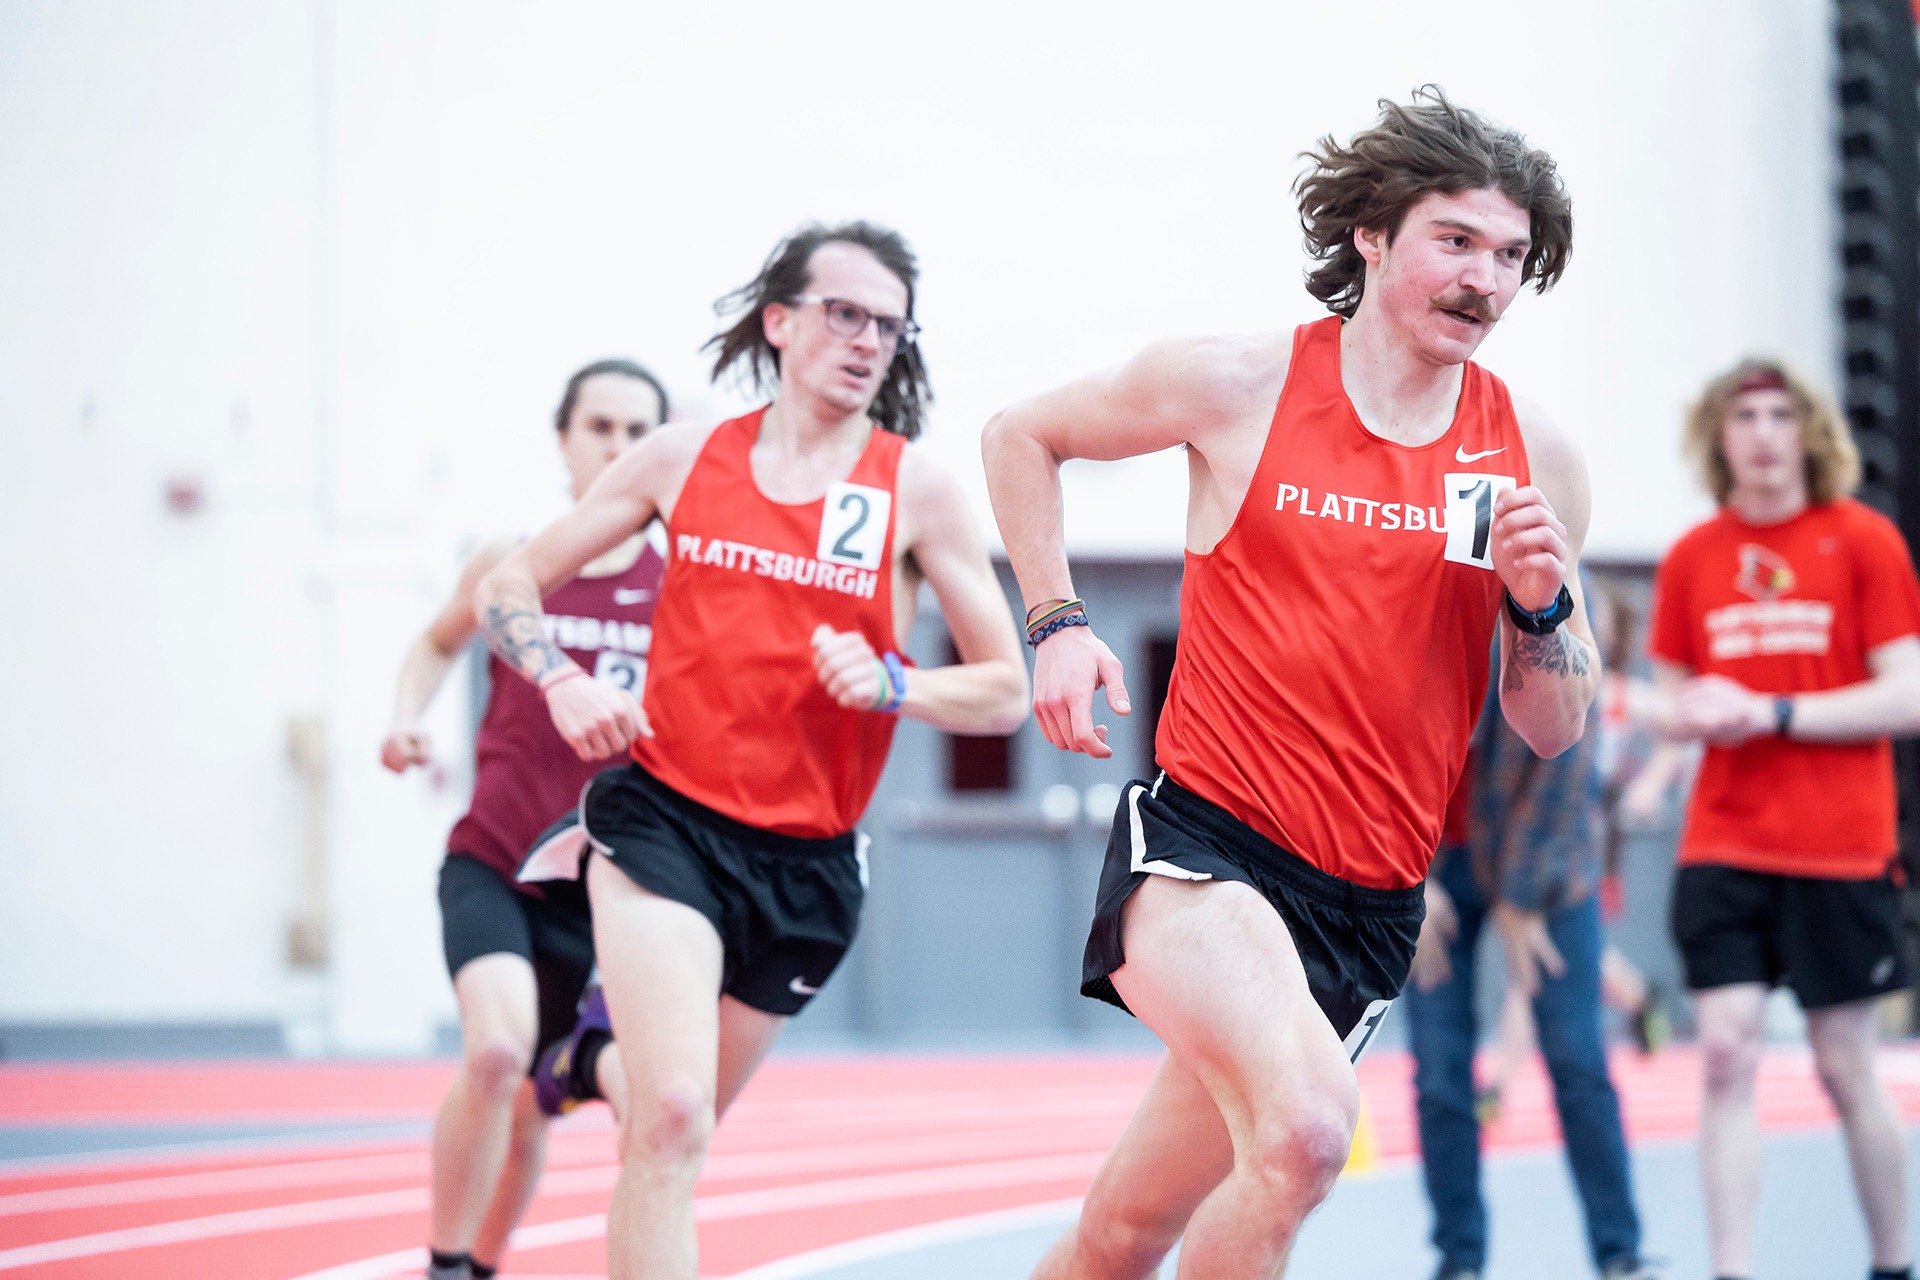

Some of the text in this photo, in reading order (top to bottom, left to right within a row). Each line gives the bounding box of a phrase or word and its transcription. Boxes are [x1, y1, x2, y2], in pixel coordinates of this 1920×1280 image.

[831, 494, 870, 560] 2
[1458, 480, 1492, 560] 1
[676, 533, 878, 600] PLATTSBURGH
[1350, 1006, 1389, 1065] 1
